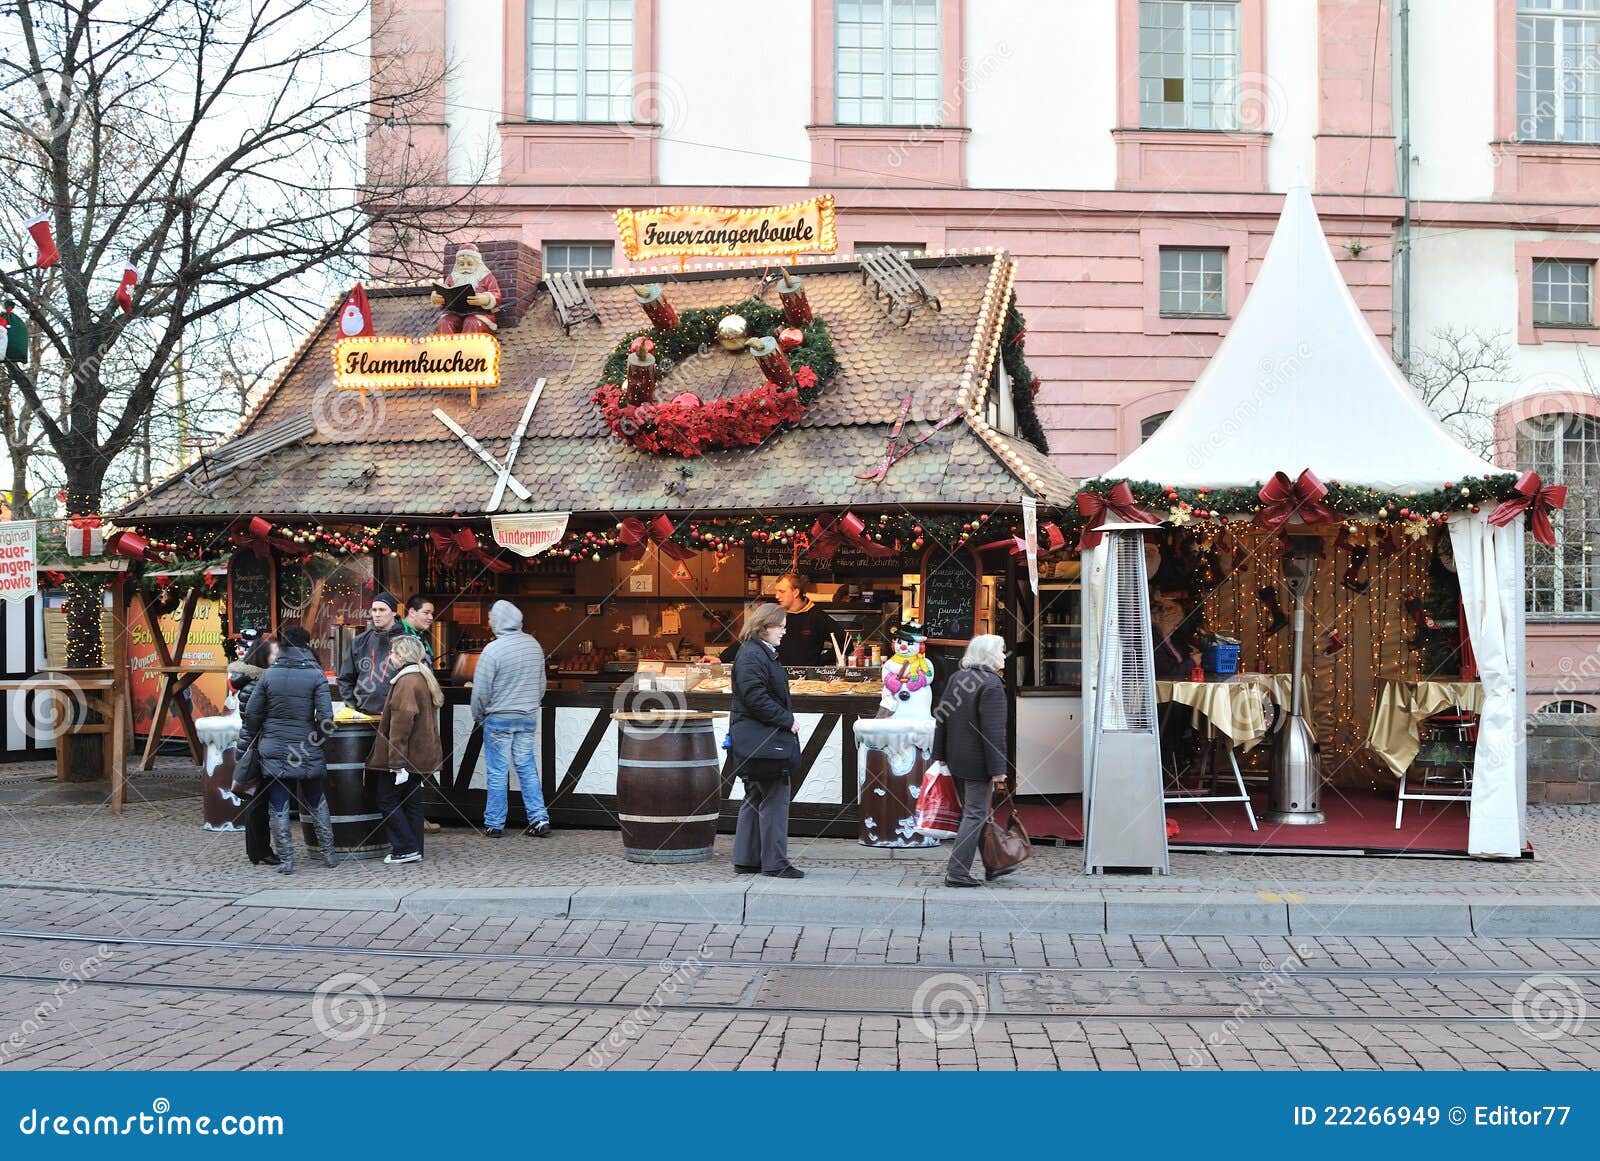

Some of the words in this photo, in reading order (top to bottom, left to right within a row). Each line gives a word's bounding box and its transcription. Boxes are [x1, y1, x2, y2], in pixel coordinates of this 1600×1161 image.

[644, 218, 813, 250] Feuerzangenbowle
[345, 350, 488, 374] Flammkuchen
[0, 530, 30, 545] riginal
[498, 527, 560, 547] Kinderpunsch
[0, 546, 30, 559] euer-
[0, 560, 35, 576] ngen-
[636, 581, 646, 590] 21
